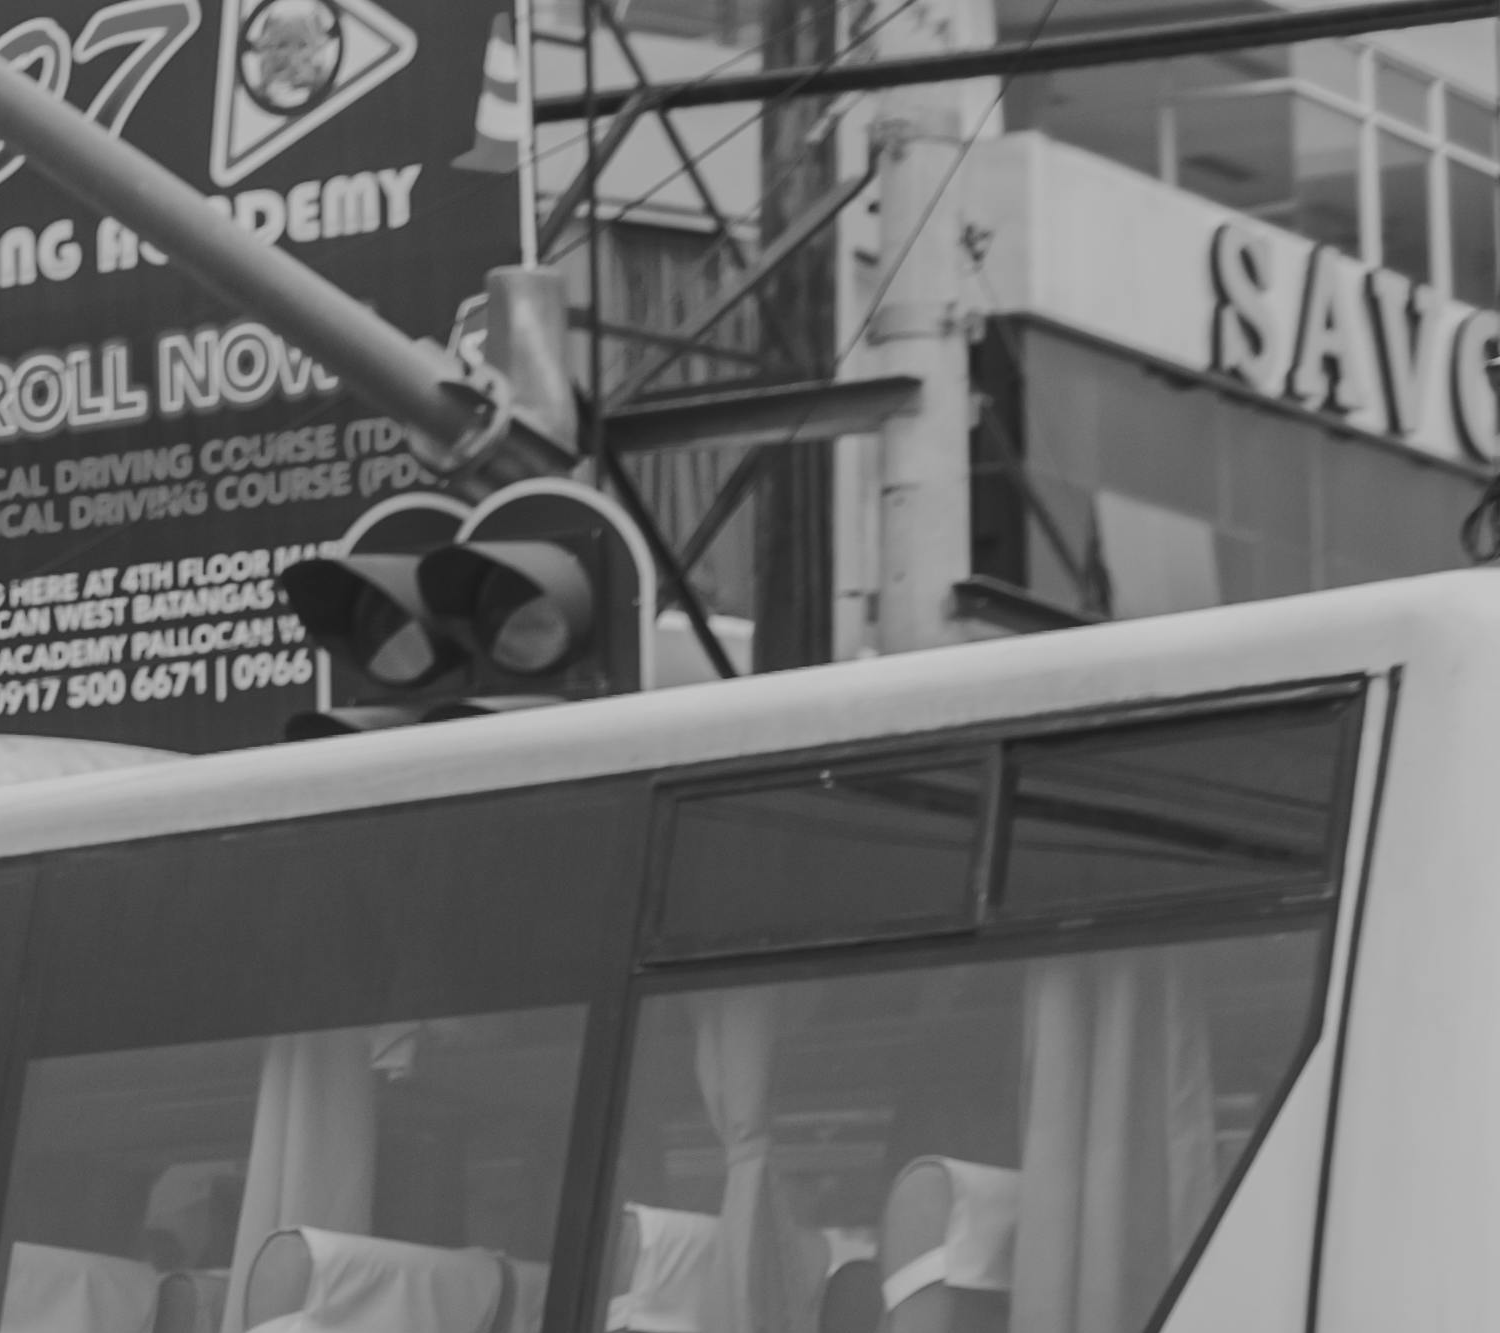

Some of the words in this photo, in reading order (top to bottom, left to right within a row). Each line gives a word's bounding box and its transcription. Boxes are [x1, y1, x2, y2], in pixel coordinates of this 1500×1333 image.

[96, 163, 422, 274] ADEMY
[54, 443, 193, 495] DRIVING
[199, 424, 337, 475] COURSE
[343, 416, 403, 462] (TD
[69, 479, 208, 531] DRIVING
[215, 460, 352, 511] COURSE
[8, 572, 80, 608] HERE
[82, 567, 119, 600] AT
[119, 560, 174, 594] 4TH
[176, 549, 271, 588] FLOOR
[52, 596, 129, 632] WEST
[131, 578, 275, 624] BATANGAS
[130, 616, 275, 661] PALLOCAN
[66, 668, 127, 709] 500
[130, 659, 207, 702] 6671
[231, 647, 313, 691] 0966
